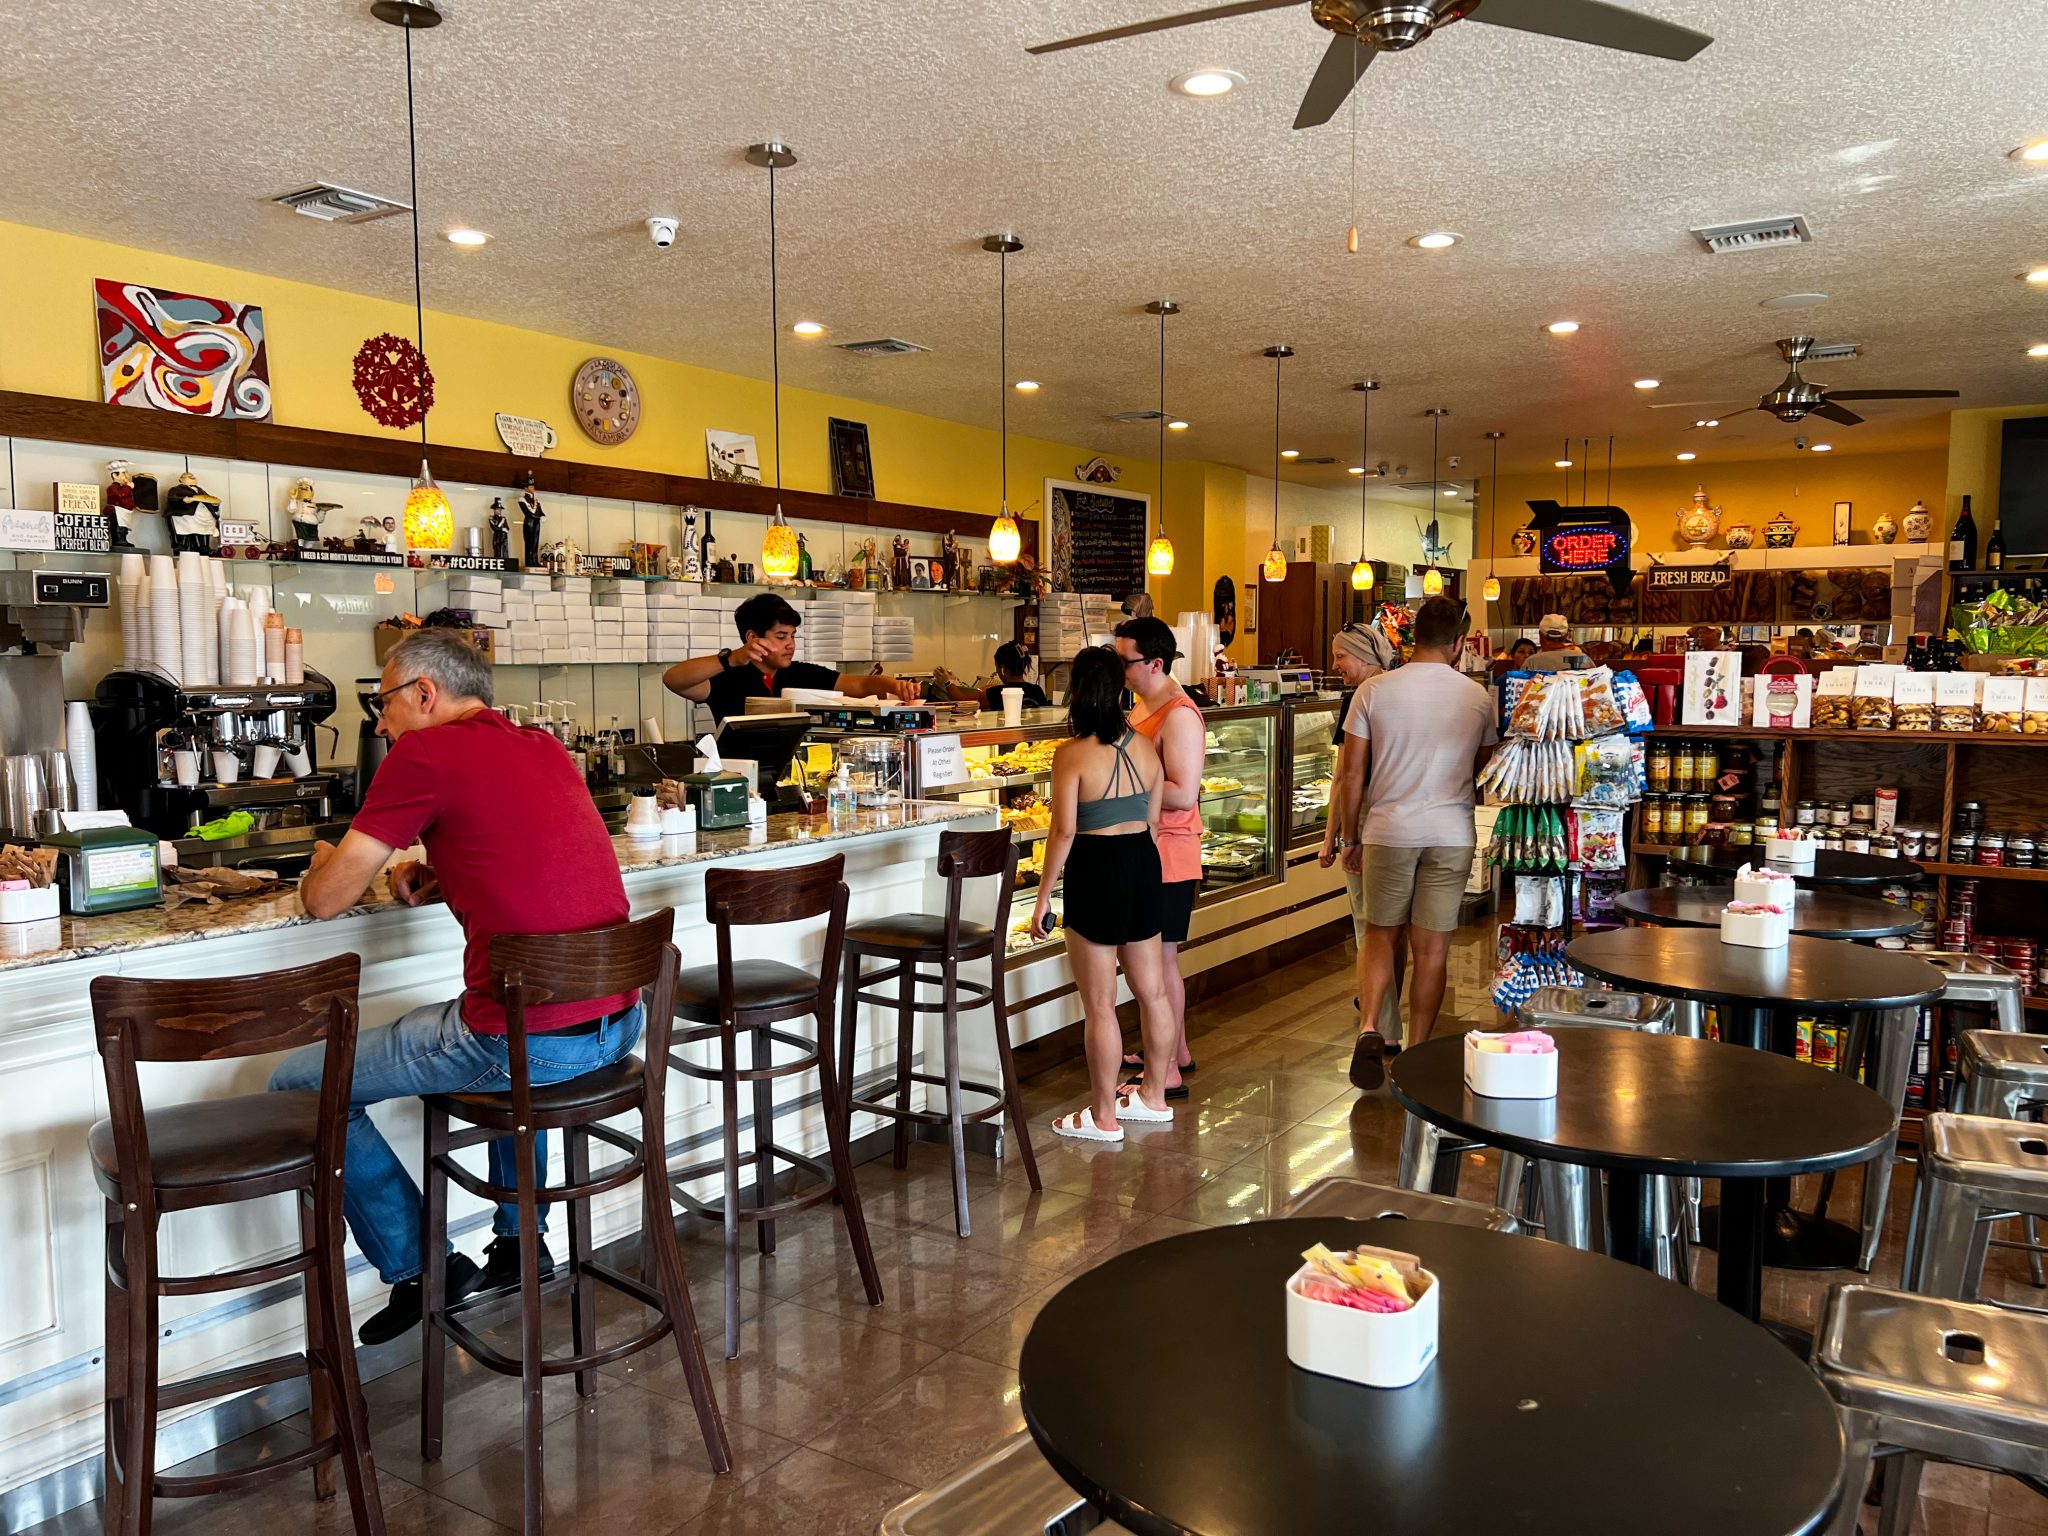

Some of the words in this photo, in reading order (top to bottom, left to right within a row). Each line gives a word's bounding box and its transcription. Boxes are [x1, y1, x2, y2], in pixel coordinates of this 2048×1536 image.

[512, 441, 537, 453] COFFEE
[63, 499, 97, 510] FRIEND
[54, 514, 109, 528] COFFEE
[55, 526, 73, 539] AND
[74, 527, 110, 540] FRIENDS
[55, 537, 60, 550] A
[61, 538, 88, 551] PERFECT
[89, 539, 110, 552] BLEND
[1553, 534, 1616, 550] ORDER
[303, 551, 316, 560] NEED
[316, 552, 320, 560] A
[321, 552, 329, 561] SIX
[329, 553, 347, 562] MONTH
[347, 553, 371, 563] VACATION
[371, 554, 386, 564] TWICE
[386, 555, 391, 564] A
[391, 556, 402, 565] YEAR
[450, 556, 505, 570] #COFFEE
[582, 556, 604, 569] DAILY
[608, 557, 631, 571] RIND
[1560, 549, 1609, 565] HERE
[1654, 570, 1688, 585] FRESH
[1690, 570, 1726, 584] BREAD
[942, 745, 956, 753] Order
[938, 758, 952, 766] Other
